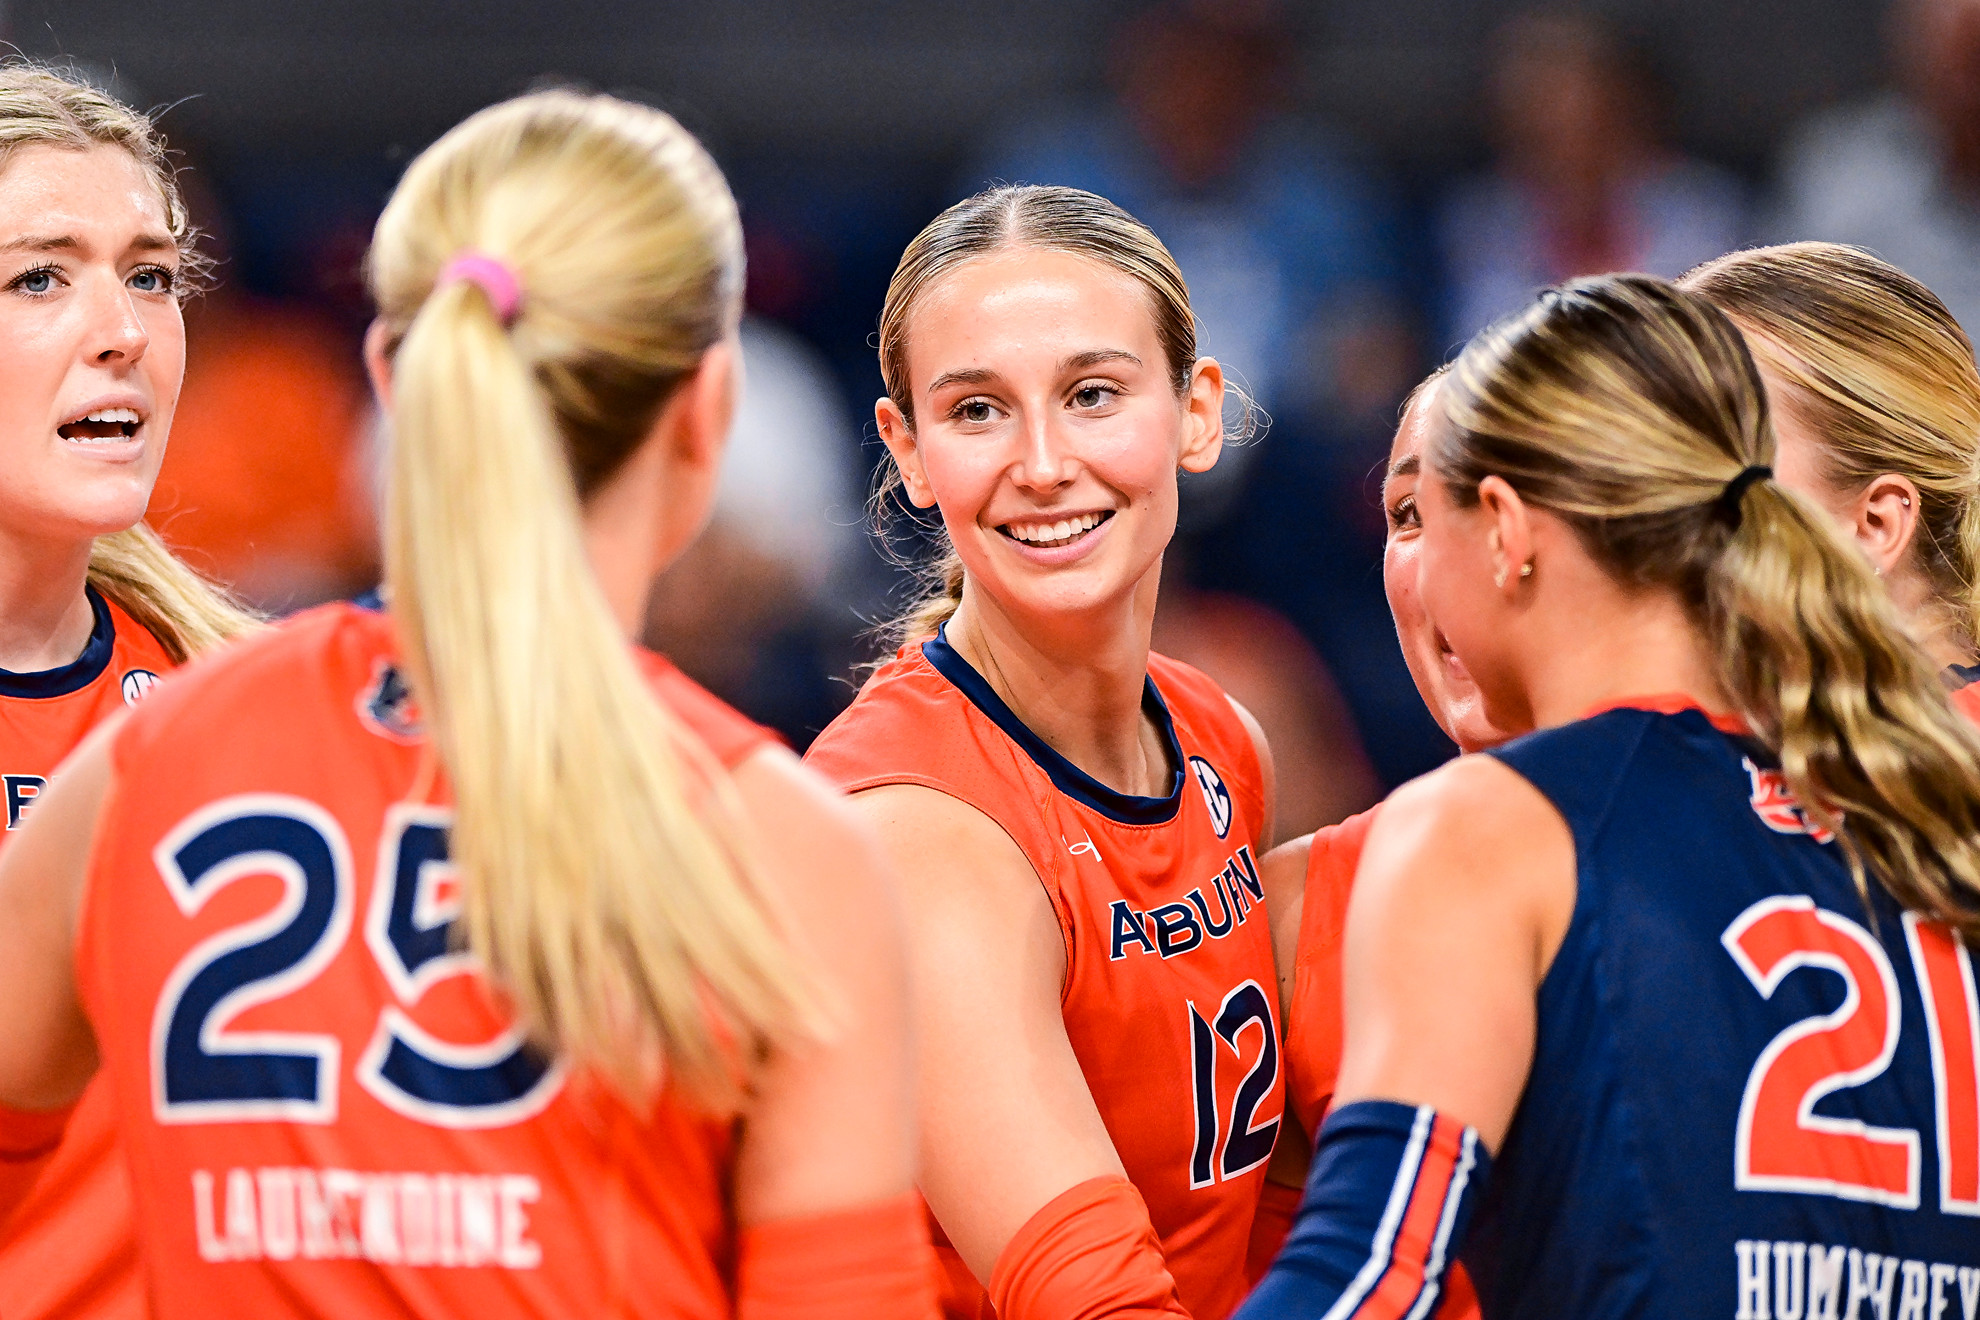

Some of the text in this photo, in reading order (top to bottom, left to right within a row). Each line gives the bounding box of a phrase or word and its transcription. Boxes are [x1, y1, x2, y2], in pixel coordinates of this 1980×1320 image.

[1188, 756, 1231, 839] EC
[153, 794, 567, 1128] 25
[1186, 978, 1281, 1190] 12
[1720, 894, 1980, 1216] 21
